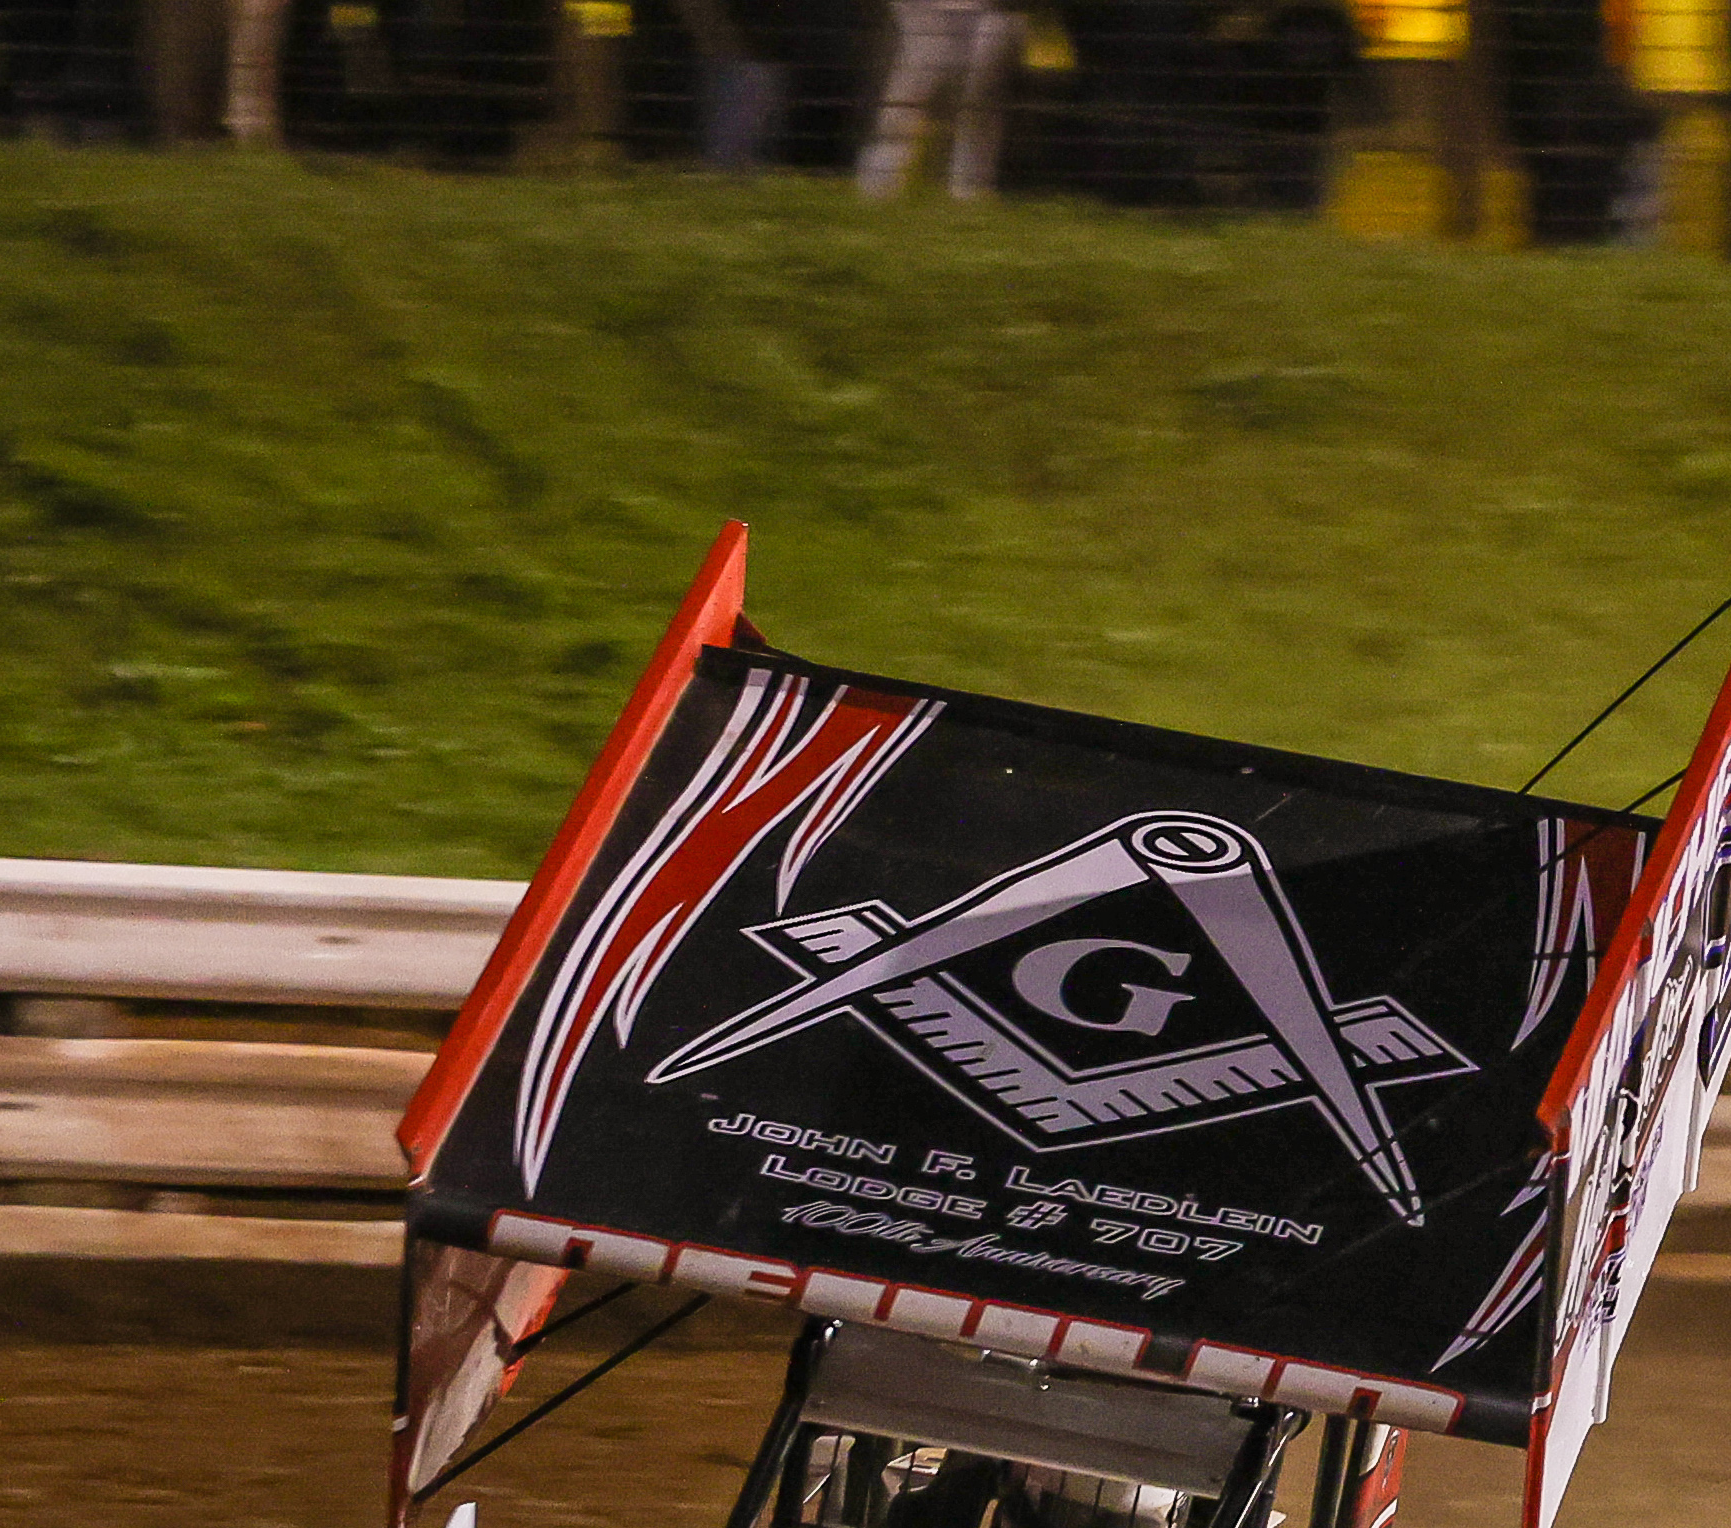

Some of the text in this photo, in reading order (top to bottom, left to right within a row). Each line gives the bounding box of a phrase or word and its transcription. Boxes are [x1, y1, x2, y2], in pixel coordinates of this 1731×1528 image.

[1011, 937, 1197, 1037] G
[708, 1112, 1324, 1245] JOHN F. LAEDLEIN
[759, 1153, 1244, 1262] LODGE # 707
[779, 1198, 1186, 1301] 100th Anniversary
